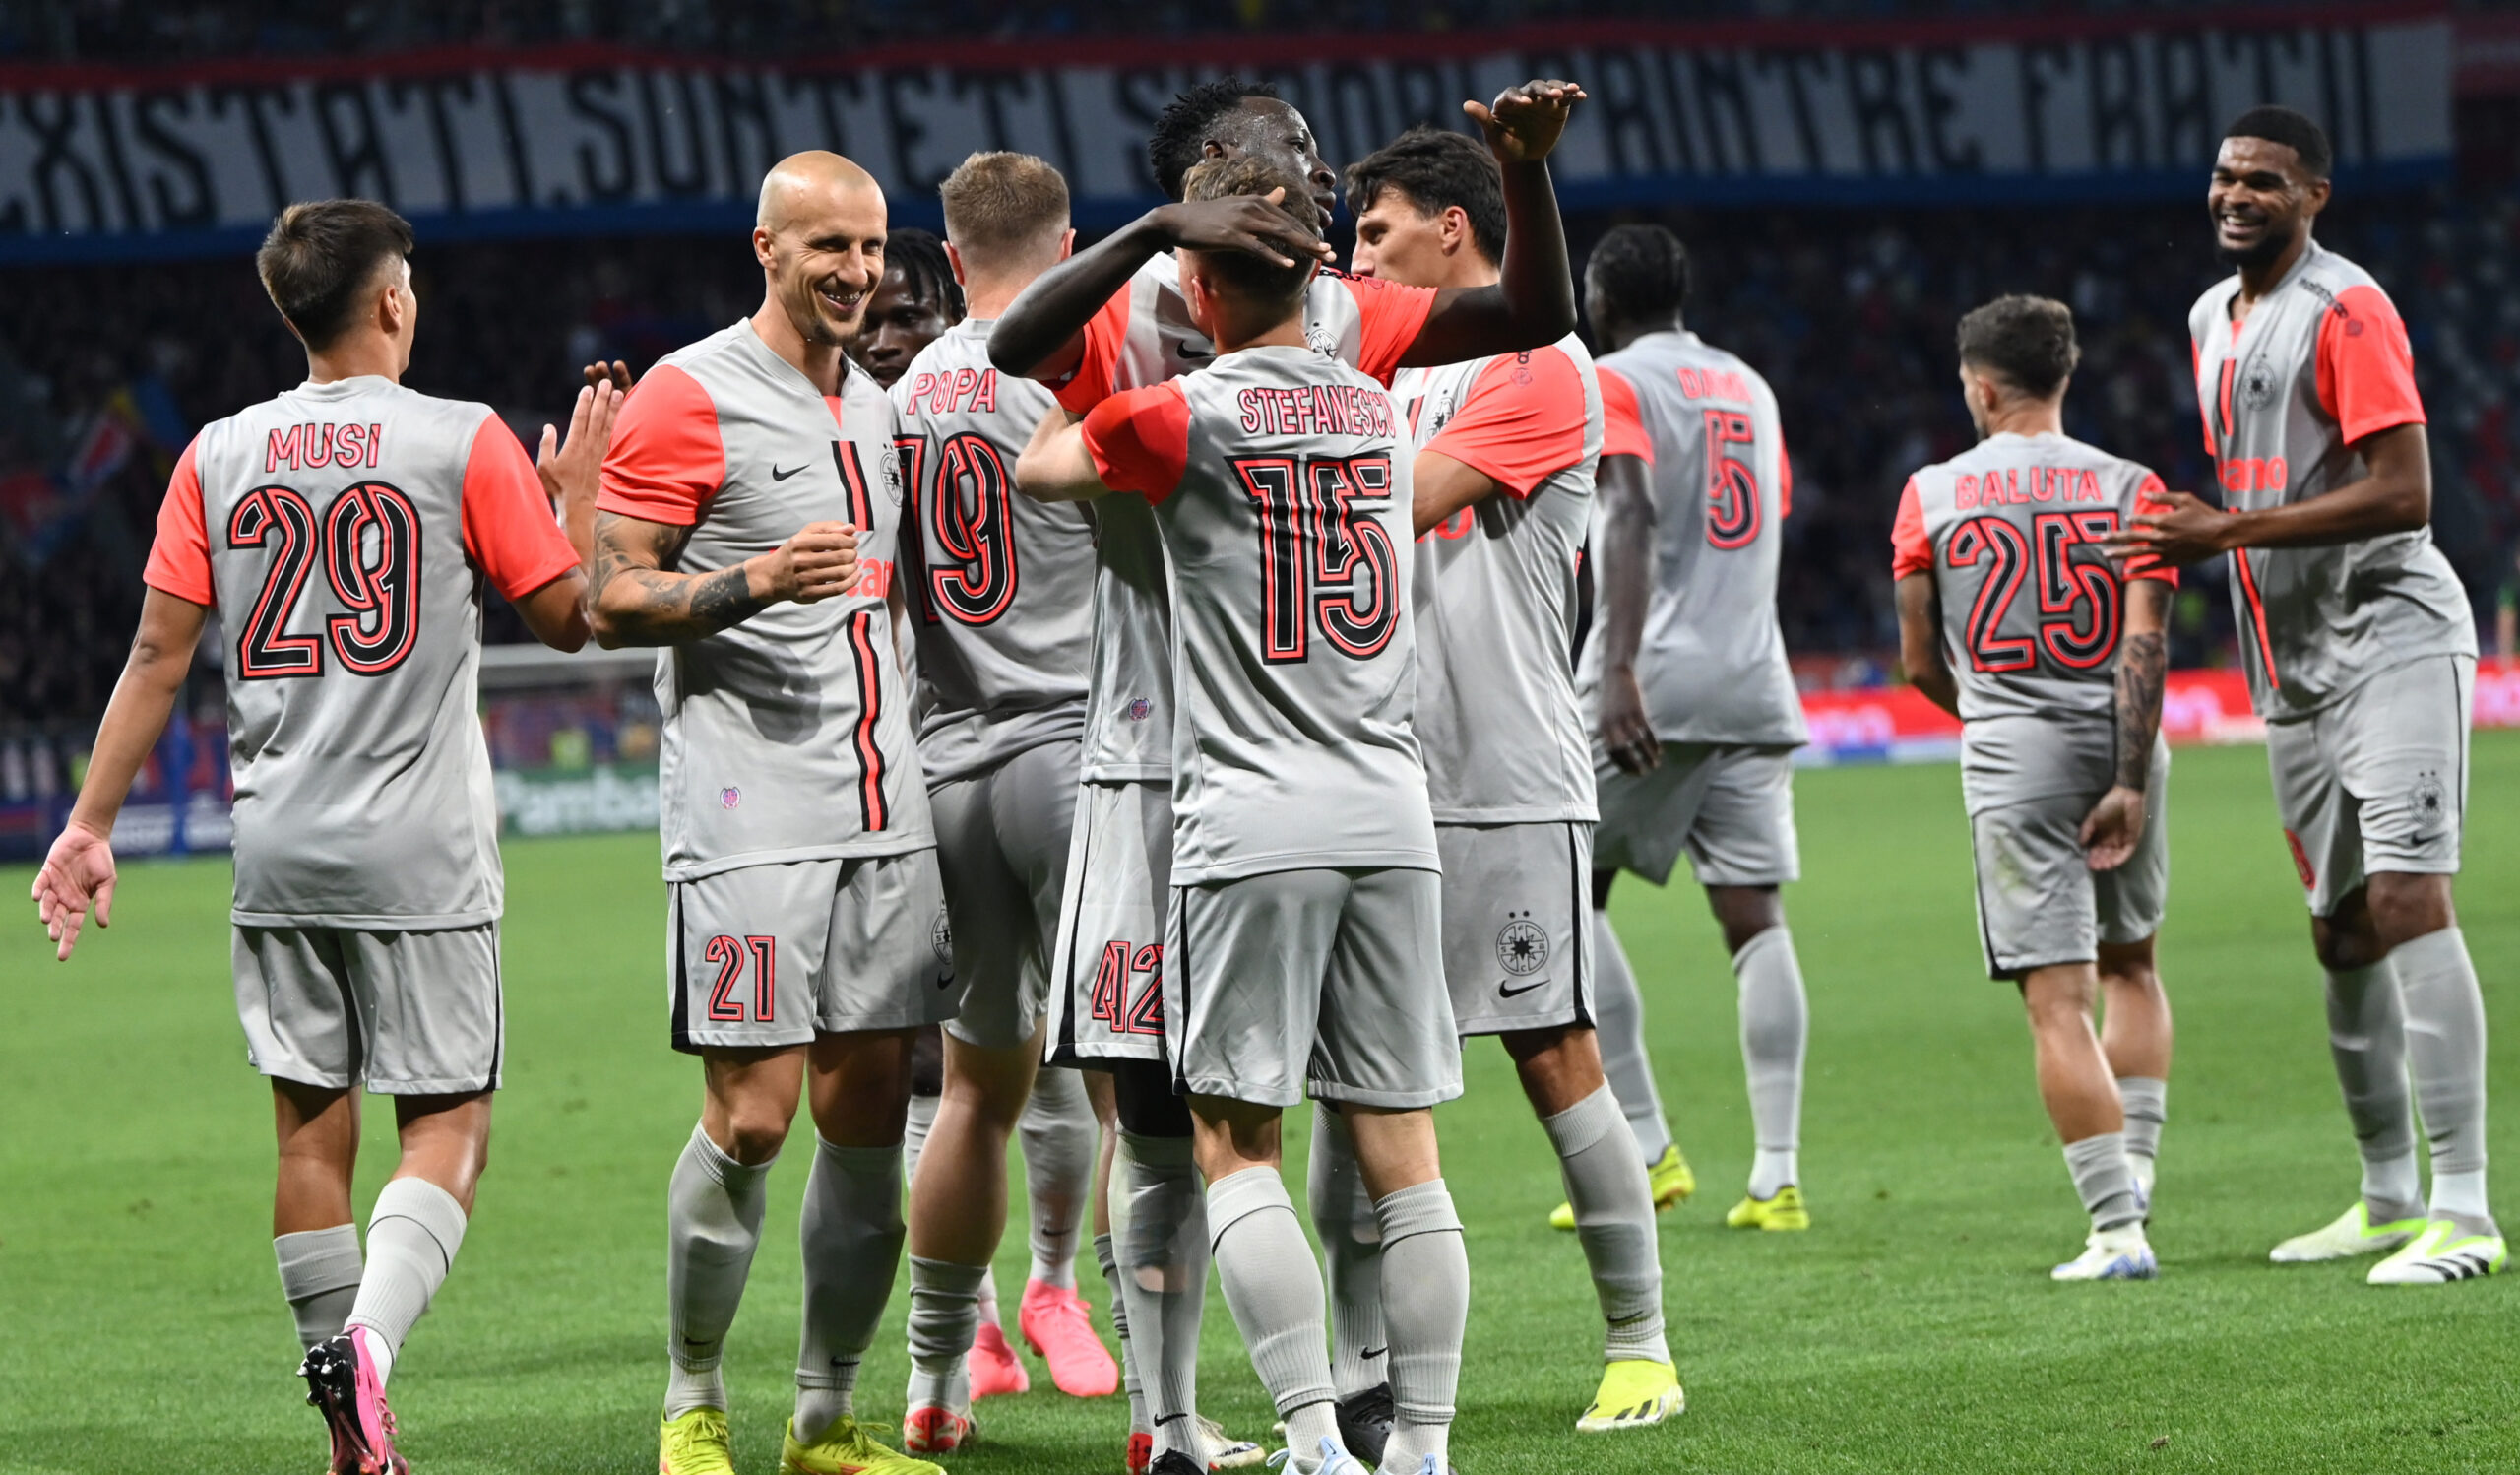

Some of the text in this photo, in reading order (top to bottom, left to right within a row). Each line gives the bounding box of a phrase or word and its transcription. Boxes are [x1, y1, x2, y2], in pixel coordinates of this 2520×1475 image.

[0, 77, 569, 230] XISTATI.
[265, 423, 381, 473] MUSI
[906, 368, 996, 415] POPA
[1237, 384, 1396, 439] STEFANESCU
[893, 431, 1020, 628] 19
[1703, 410, 1762, 550] 5
[1955, 466, 2104, 511] BALUTA
[226, 481, 423, 681] 29
[1223, 452, 1401, 666] 15
[1947, 508, 2120, 673] 25
[705, 935, 776, 1022] 21
[1092, 940, 1166, 1035] 42
